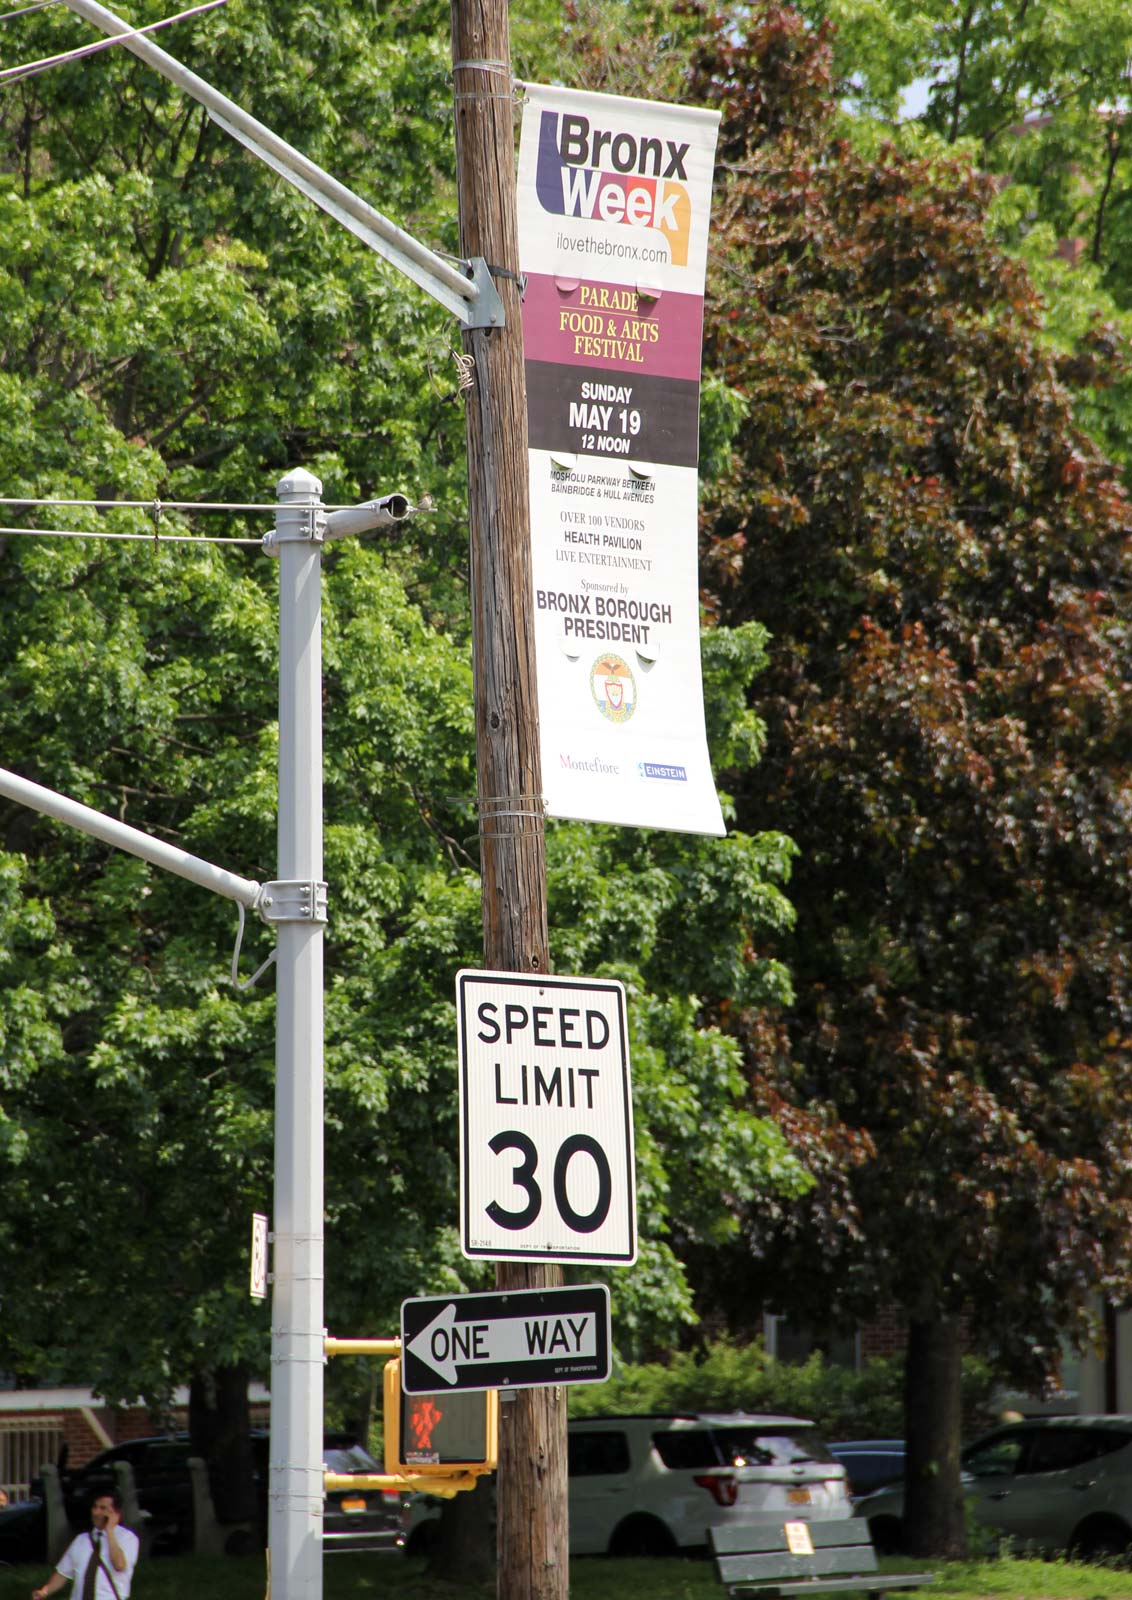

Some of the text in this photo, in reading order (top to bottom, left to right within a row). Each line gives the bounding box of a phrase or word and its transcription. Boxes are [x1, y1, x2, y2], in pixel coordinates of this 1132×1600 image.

[560, 113, 691, 181] Bronx
[560, 166, 681, 231] Week
[556, 232, 668, 264] ilovethebronx.com
[579, 286, 639, 312] PARADE
[559, 311, 659, 343] FOOD & ARTS
[573, 335, 644, 363] FESTIVAL
[581, 382, 633, 404] SUNDAY
[568, 402, 641, 435] MAY 19
[581, 434, 631, 454] 12 NOON
[550, 470, 656, 491] MOSHOLU PARKWAY BETWEEN
[551, 483, 655, 504] BAINBRIDGE & HULL AVENUES
[560, 510, 645, 531] OVER 100 VENDORS
[564, 530, 642, 551] HEALTH PAVILION
[555, 549, 653, 571] LIVE ENTERTAINMENT
[580, 579, 630, 597] Sponsored by
[536, 590, 672, 624] BRONX BOROUGH
[564, 617, 650, 645] PRESIDENT
[559, 753, 620, 775] Montefiore
[645, 765, 686, 779] EINSTEIN
[477, 1002, 610, 1050] SPEED
[495, 1063, 600, 1109] LIMIT
[485, 1130, 612, 1234] 30
[430, 1317, 589, 1362] ONE WAY
